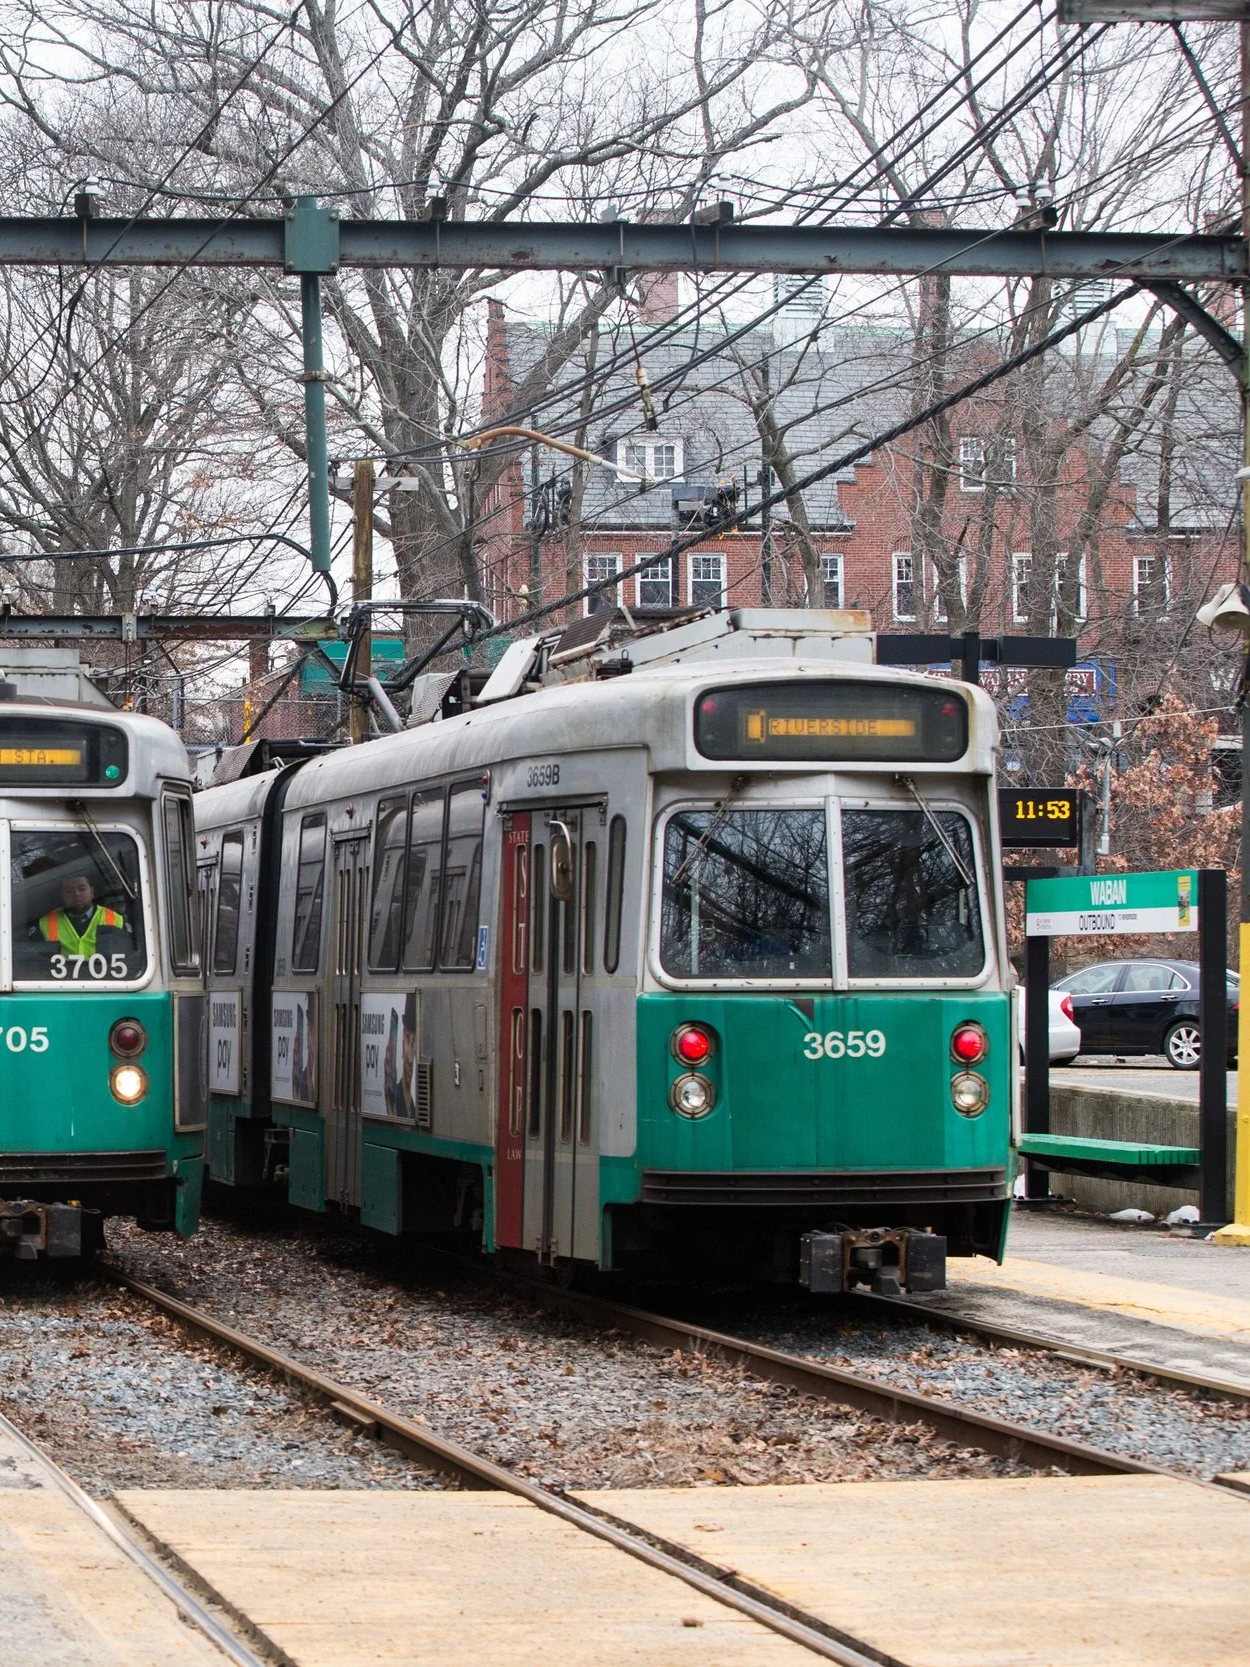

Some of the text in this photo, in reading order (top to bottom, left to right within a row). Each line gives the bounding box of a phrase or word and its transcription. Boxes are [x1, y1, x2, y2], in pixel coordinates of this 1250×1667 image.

[770, 719, 878, 735] RIVERSIDE
[14, 750, 55, 764] STA.
[527, 763, 560, 788] 3659B
[1015, 800, 1070, 819] 11:53
[509, 831, 529, 843] STATE
[1090, 879, 1127, 906] WABAN
[1079, 913, 1115, 931] OUTBOUND
[50, 953, 128, 979] 3705
[212, 1002, 236, 1028] SAMSUNG
[274, 1008, 293, 1028] SAMSUNG
[362, 1013, 385, 1035] SAMSUNG
[278, 1036, 290, 1066] pay
[803, 1029, 886, 1060] 3659
[216, 1038, 232, 1080] pay
[365, 1044, 379, 1078] pay
[507, 1149, 521, 1160] LAW
